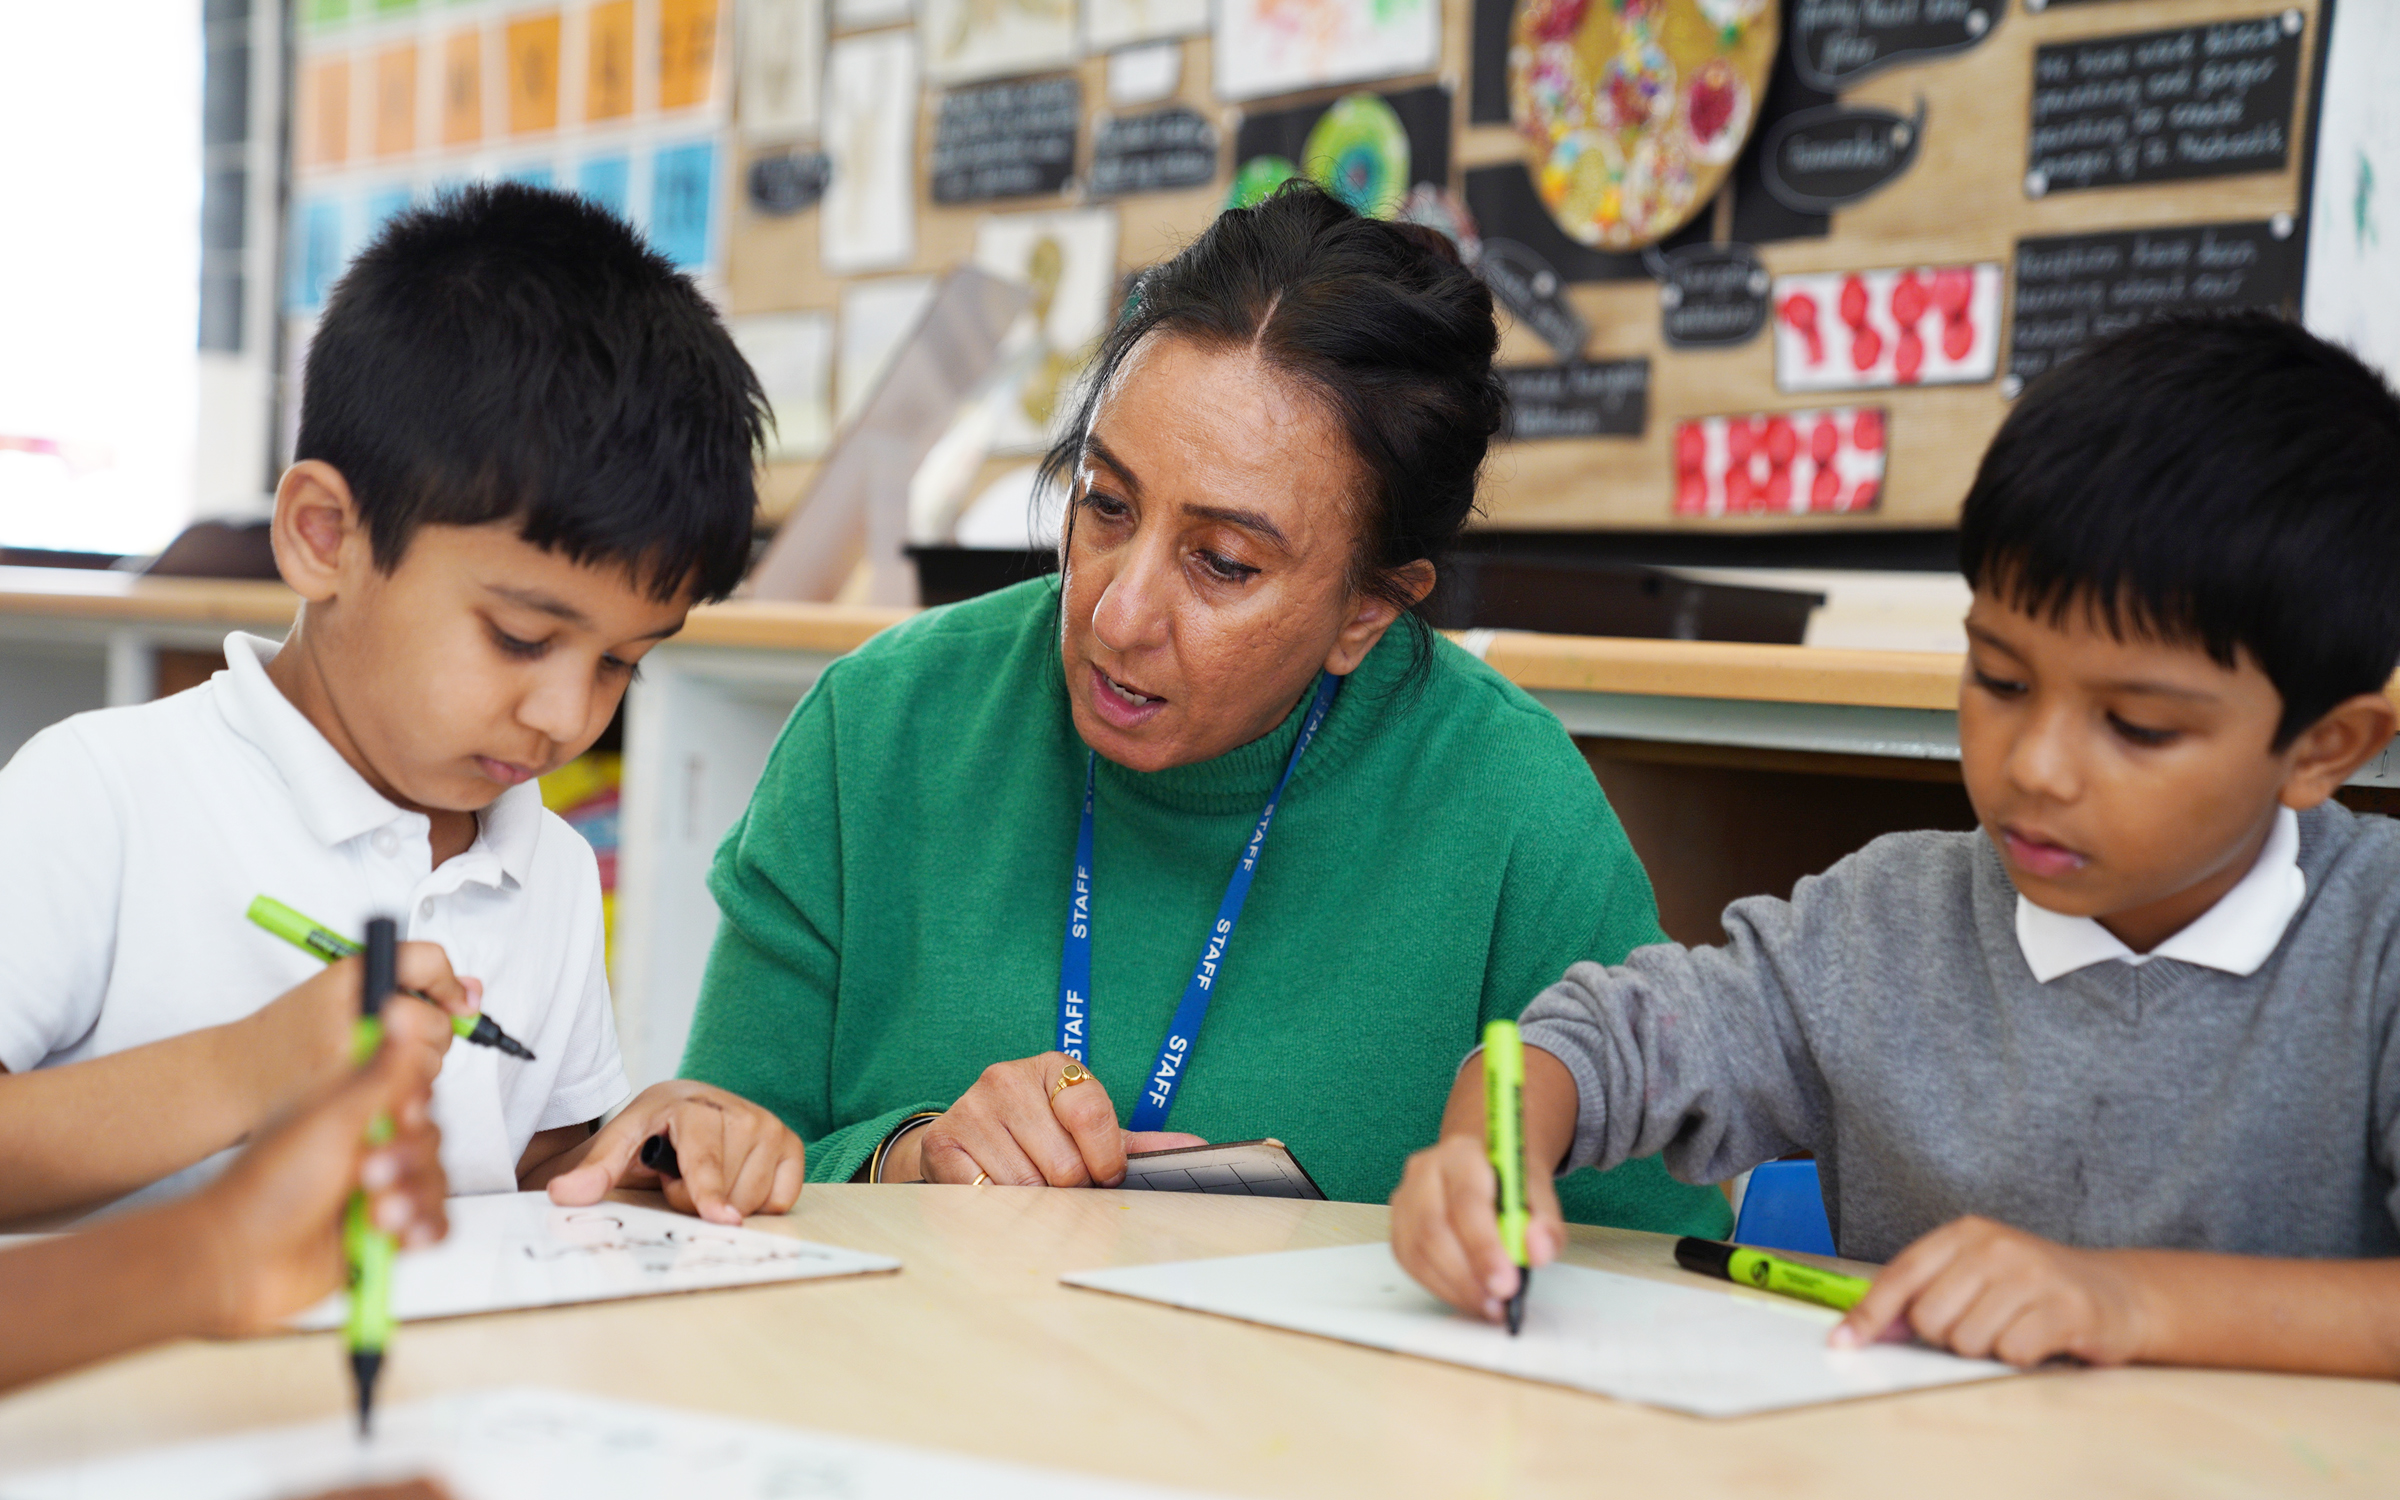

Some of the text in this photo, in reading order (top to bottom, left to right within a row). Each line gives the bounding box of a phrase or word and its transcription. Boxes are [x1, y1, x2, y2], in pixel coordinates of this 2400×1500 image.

[1243, 804, 1274, 871] STAFF
[1072, 866, 1090, 939] STAFF
[1197, 918, 1231, 991] STAFF
[1148, 1035, 1188, 1109] STAFF
